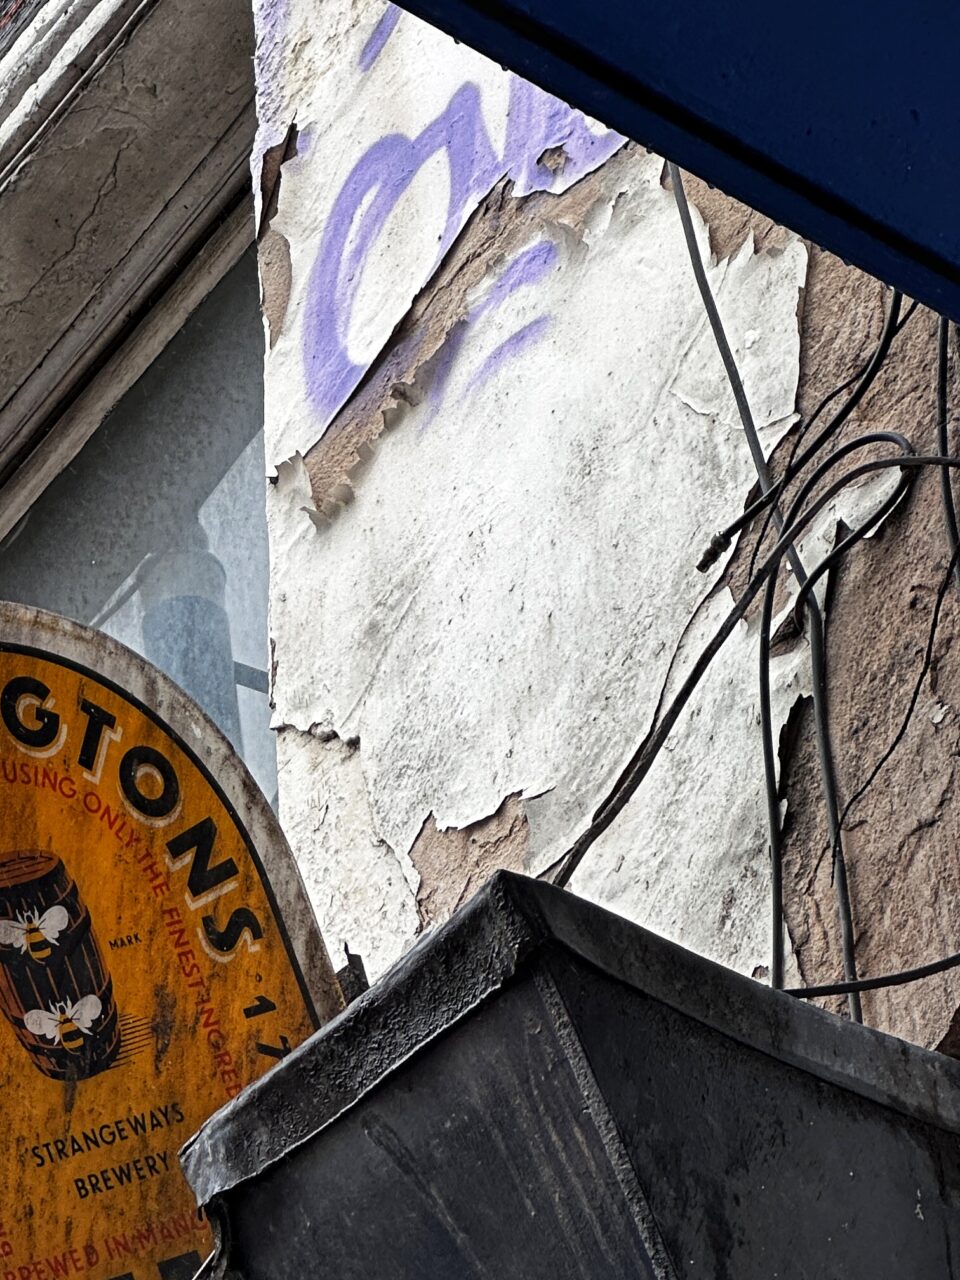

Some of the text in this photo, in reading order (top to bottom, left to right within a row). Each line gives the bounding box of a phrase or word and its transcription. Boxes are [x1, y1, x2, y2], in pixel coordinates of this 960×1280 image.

[1, 759, 77, 798] USING
[82, 791, 140, 849] ONLY
[136, 849, 171, 898] THE
[162, 906, 206, 989] FINEST
[107, 932, 143, 951] MARK
[31, 1102, 186, 1168] STRANGEWAYS
[73, 1150, 172, 1200] BREWERY
[103, 1231, 133, 1261] IN
